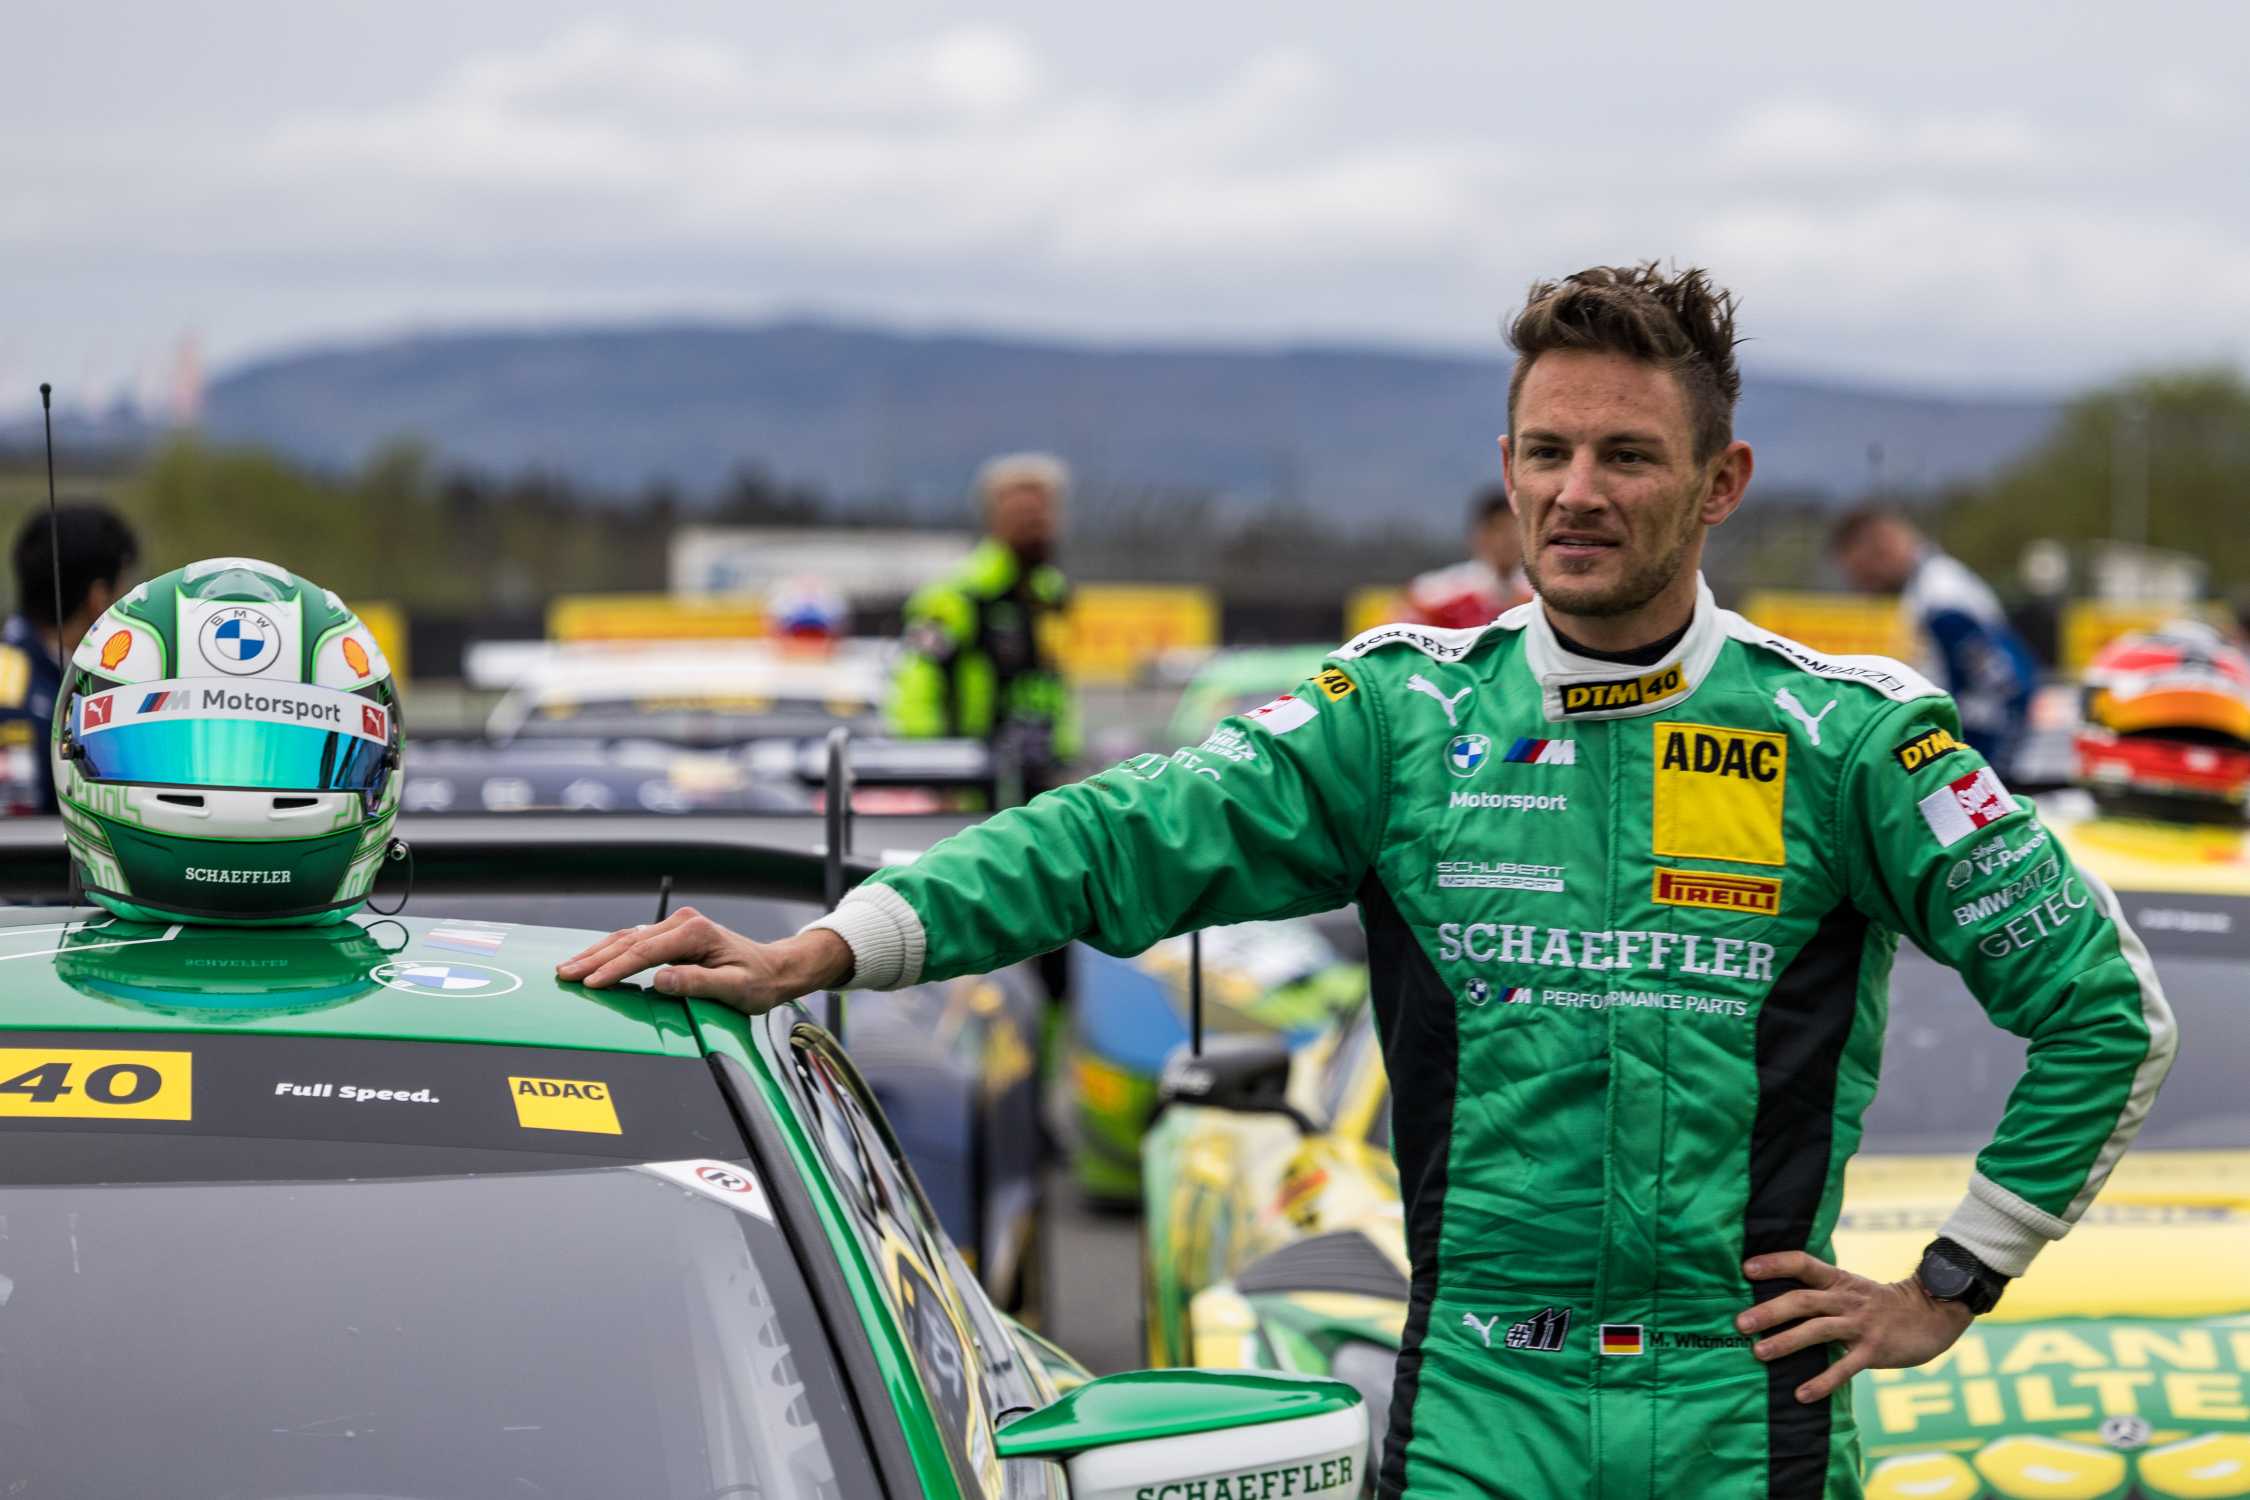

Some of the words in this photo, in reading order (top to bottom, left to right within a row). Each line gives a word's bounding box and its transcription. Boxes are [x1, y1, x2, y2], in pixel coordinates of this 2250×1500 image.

[210, 609, 270, 628] BMW
[1322, 672, 1350, 695] 40
[1567, 683, 1638, 708] DTM
[1647, 670, 1678, 695] 40
[202, 689, 341, 722] Motorsport
[1661, 731, 1780, 783] ADAC
[1901, 730, 1954, 769] DTM
[1449, 791, 1567, 812] Motorsport
[184, 866, 292, 884] SCHAEFFLER
[1436, 861, 1565, 878] SCHUBERT
[1444, 875, 1559, 889] MOTORSPORT
[1659, 873, 1776, 911] PIRELLI
[1979, 877, 2088, 957] GETEC
[1438, 922, 1776, 981] SCHAEFFLER
[1542, 989, 1682, 1010] PERFORMANCE
[1686, 995, 1748, 1016] PARTS
[0, 1063, 162, 1104] 40
[275, 1083, 333, 1097] Full
[338, 1086, 440, 1103] Speed.
[518, 1080, 604, 1101] ADAC
[1505, 1308, 1571, 1352] #11
[1651, 1332, 1670, 1346] M.
[1871, 1326, 2250, 1383] MAN
